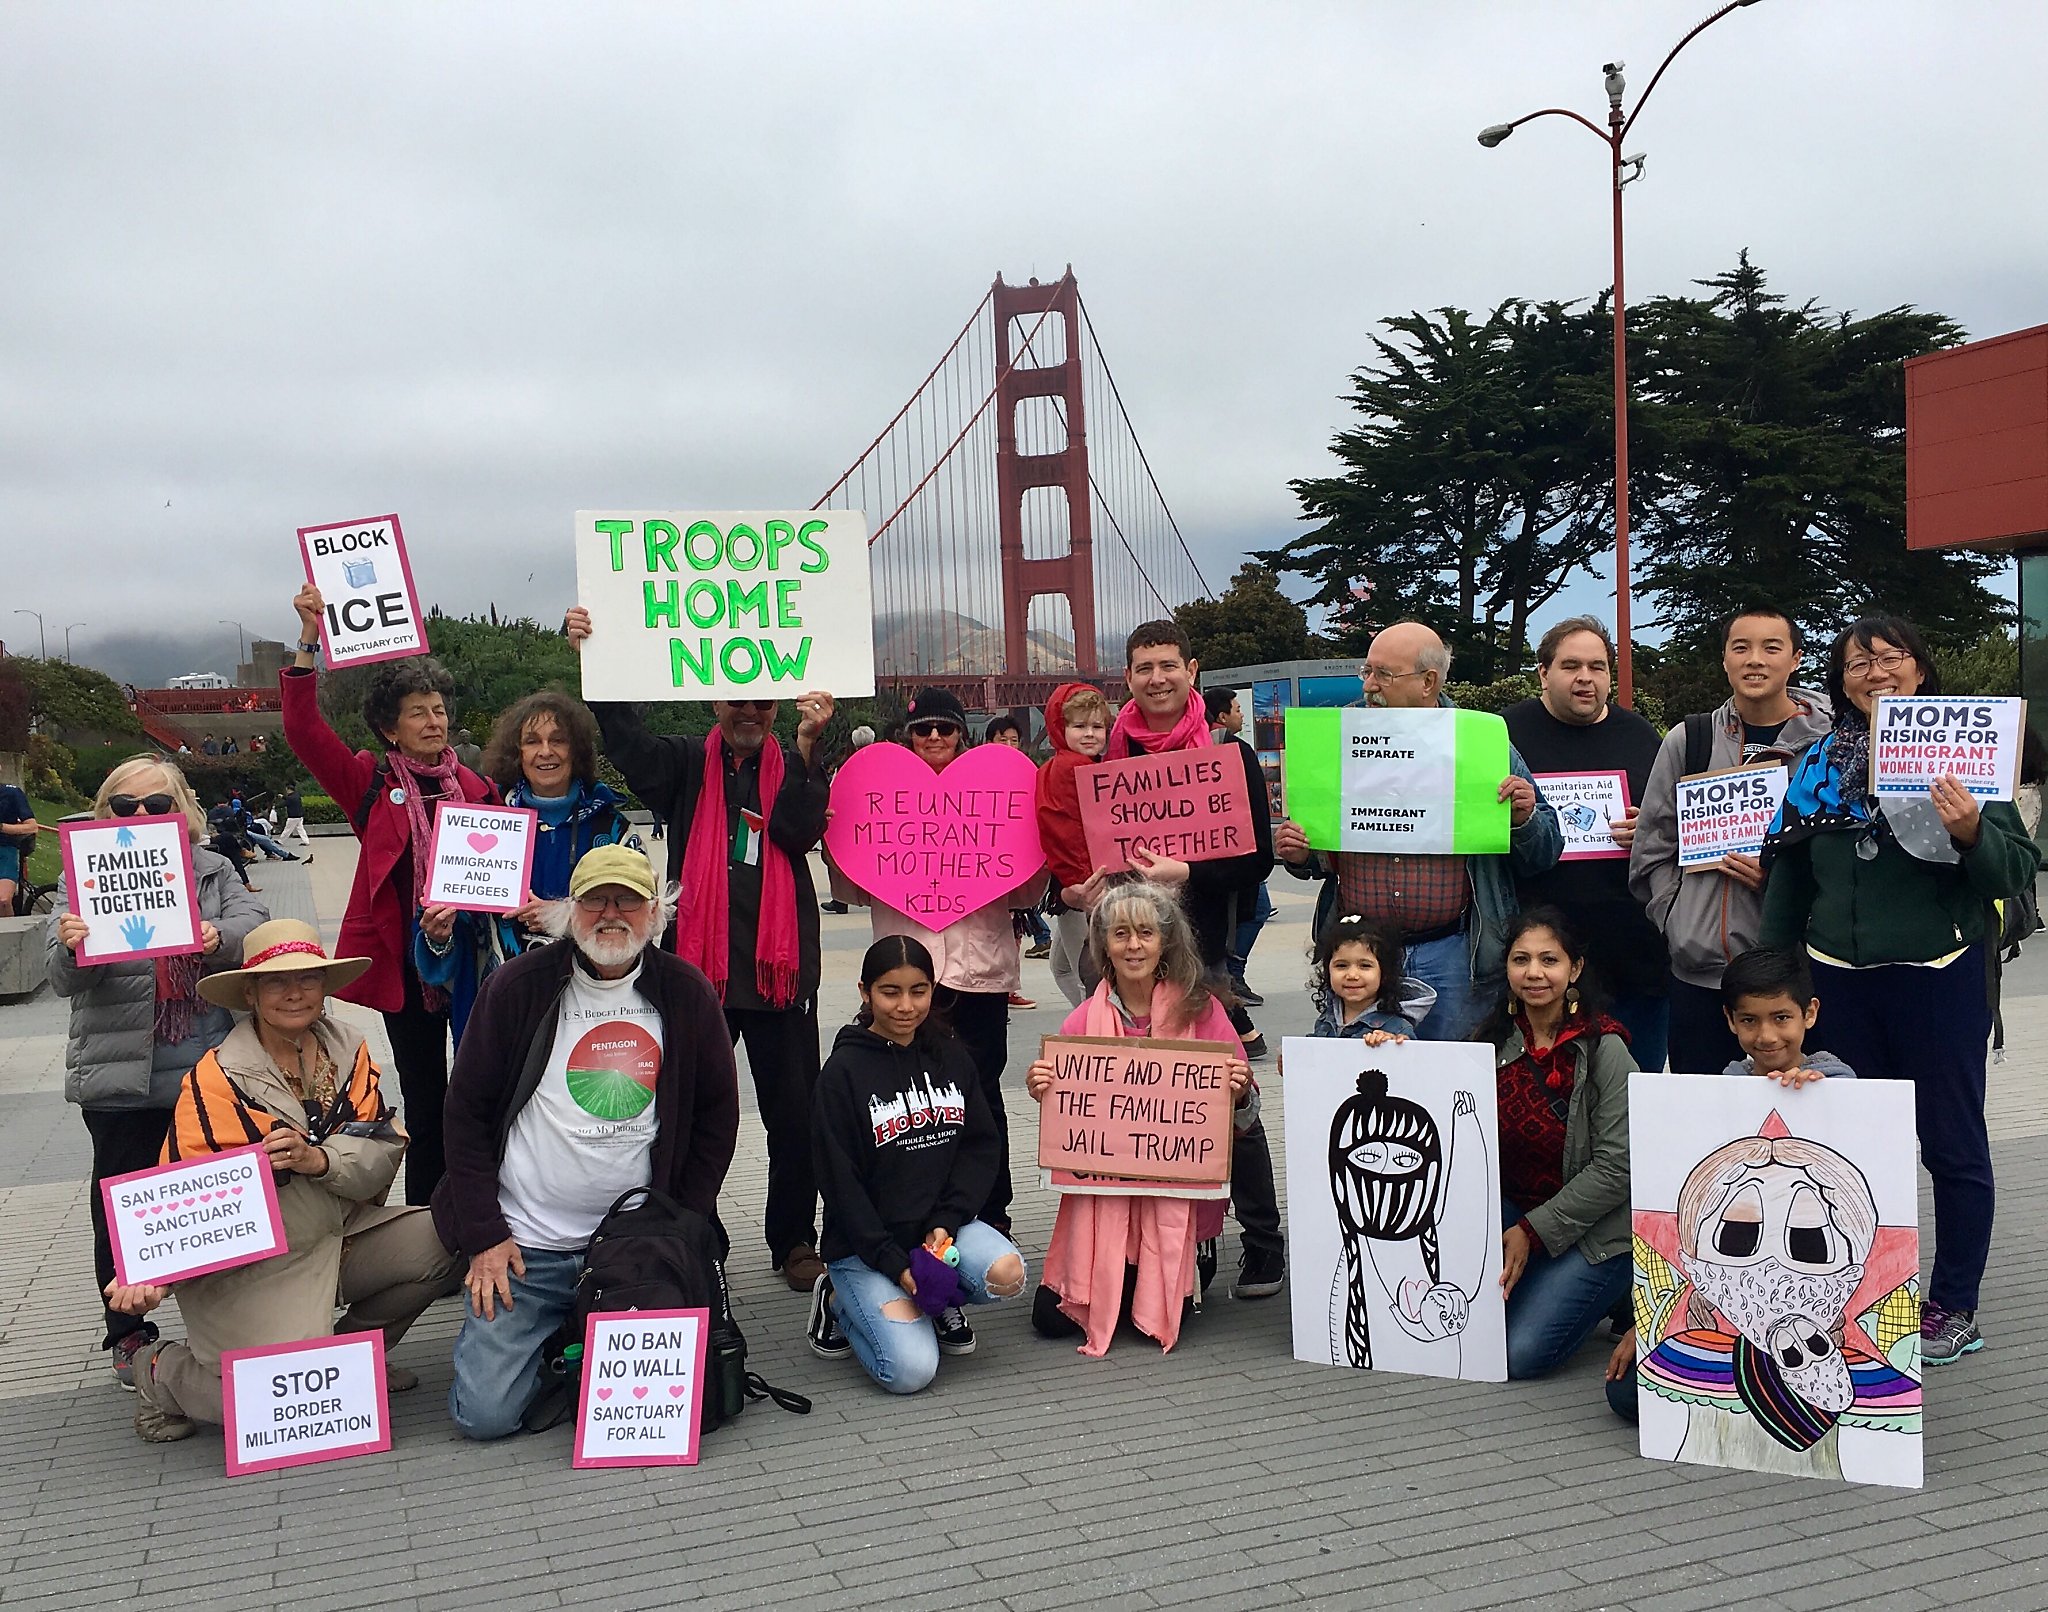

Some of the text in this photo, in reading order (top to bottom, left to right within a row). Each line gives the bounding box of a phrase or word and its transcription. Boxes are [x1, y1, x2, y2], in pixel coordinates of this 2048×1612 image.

[314, 528, 389, 556] BLOCK
[595, 520, 829, 574] TROOPS
[326, 592, 409, 636] ICE
[643, 579, 803, 629] HOME
[334, 635, 414, 655] SANCTUARY CITY
[669, 636, 813, 687] NOW
[1888, 706, 1993, 728] MOMS
[1352, 736, 1390, 745] DON'T
[1880, 729, 1998, 744] RISING FOR
[1351, 749, 1415, 759] SEPARATE
[1879, 745, 1998, 760] IMMIGRANT
[1879, 761, 1995, 776] WOMEN & FAMILES
[1093, 760, 1222, 802] FAMILIES
[1541, 780, 1613, 792] manitarian Aid
[1686, 778, 1768, 807] MOMS
[865, 790, 1029, 819] REUNITE
[1110, 792, 1232, 825] SHOULD BE
[1543, 791, 1613, 802] Never A Crime
[1351, 807, 1426, 818] IMMIGRANT
[1681, 797, 1774, 821] RISING FOR
[447, 814, 523, 832] WELCOME
[1351, 822, 1414, 832] FAMILIES!
[1681, 809, 1776, 834] IMMIGRANT
[854, 821, 1005, 847] MIGRANT
[1114, 825, 1239, 863] TOGETHER
[1582, 834, 1613, 844] Charg
[1682, 824, 1768, 846] WOMEN & FAMILE
[87, 848, 168, 873] FAMILIES
[441, 855, 518, 871] IMMIGRANTS
[877, 851, 1014, 878] MOTHERS
[98, 870, 163, 894] BELONG
[464, 871, 491, 882] AND
[89, 889, 177, 916] TOGETHER
[443, 883, 509, 898] REFUGEES
[905, 893, 967, 914] KIDS
[620, 1006, 660, 1016] PRIORITIE
[591, 1040, 637, 1051] PENTAGON
[1055, 1054, 1223, 1090] UNITE AND FREE
[1055, 1091, 1208, 1125] THE FAMILIES
[874, 1105, 965, 1148] HOOVER
[895, 1135, 925, 1147] MIDDLE
[1062, 1128, 1214, 1164] JAIL TRUMP
[120, 1166, 253, 1208] SAN FRANCISCO
[143, 1200, 243, 1236] SANCTUARY
[138, 1221, 258, 1262] CITY FOREVER
[608, 1331, 682, 1351] NO BAN
[599, 1358, 686, 1379] NO WALL
[272, 1366, 340, 1398] STOP
[273, 1398, 343, 1422] BORDER
[593, 1404, 685, 1422] SANCTUARY
[245, 1414, 371, 1448] MILITARIZATION
[607, 1426, 666, 1441] FOR ALL
